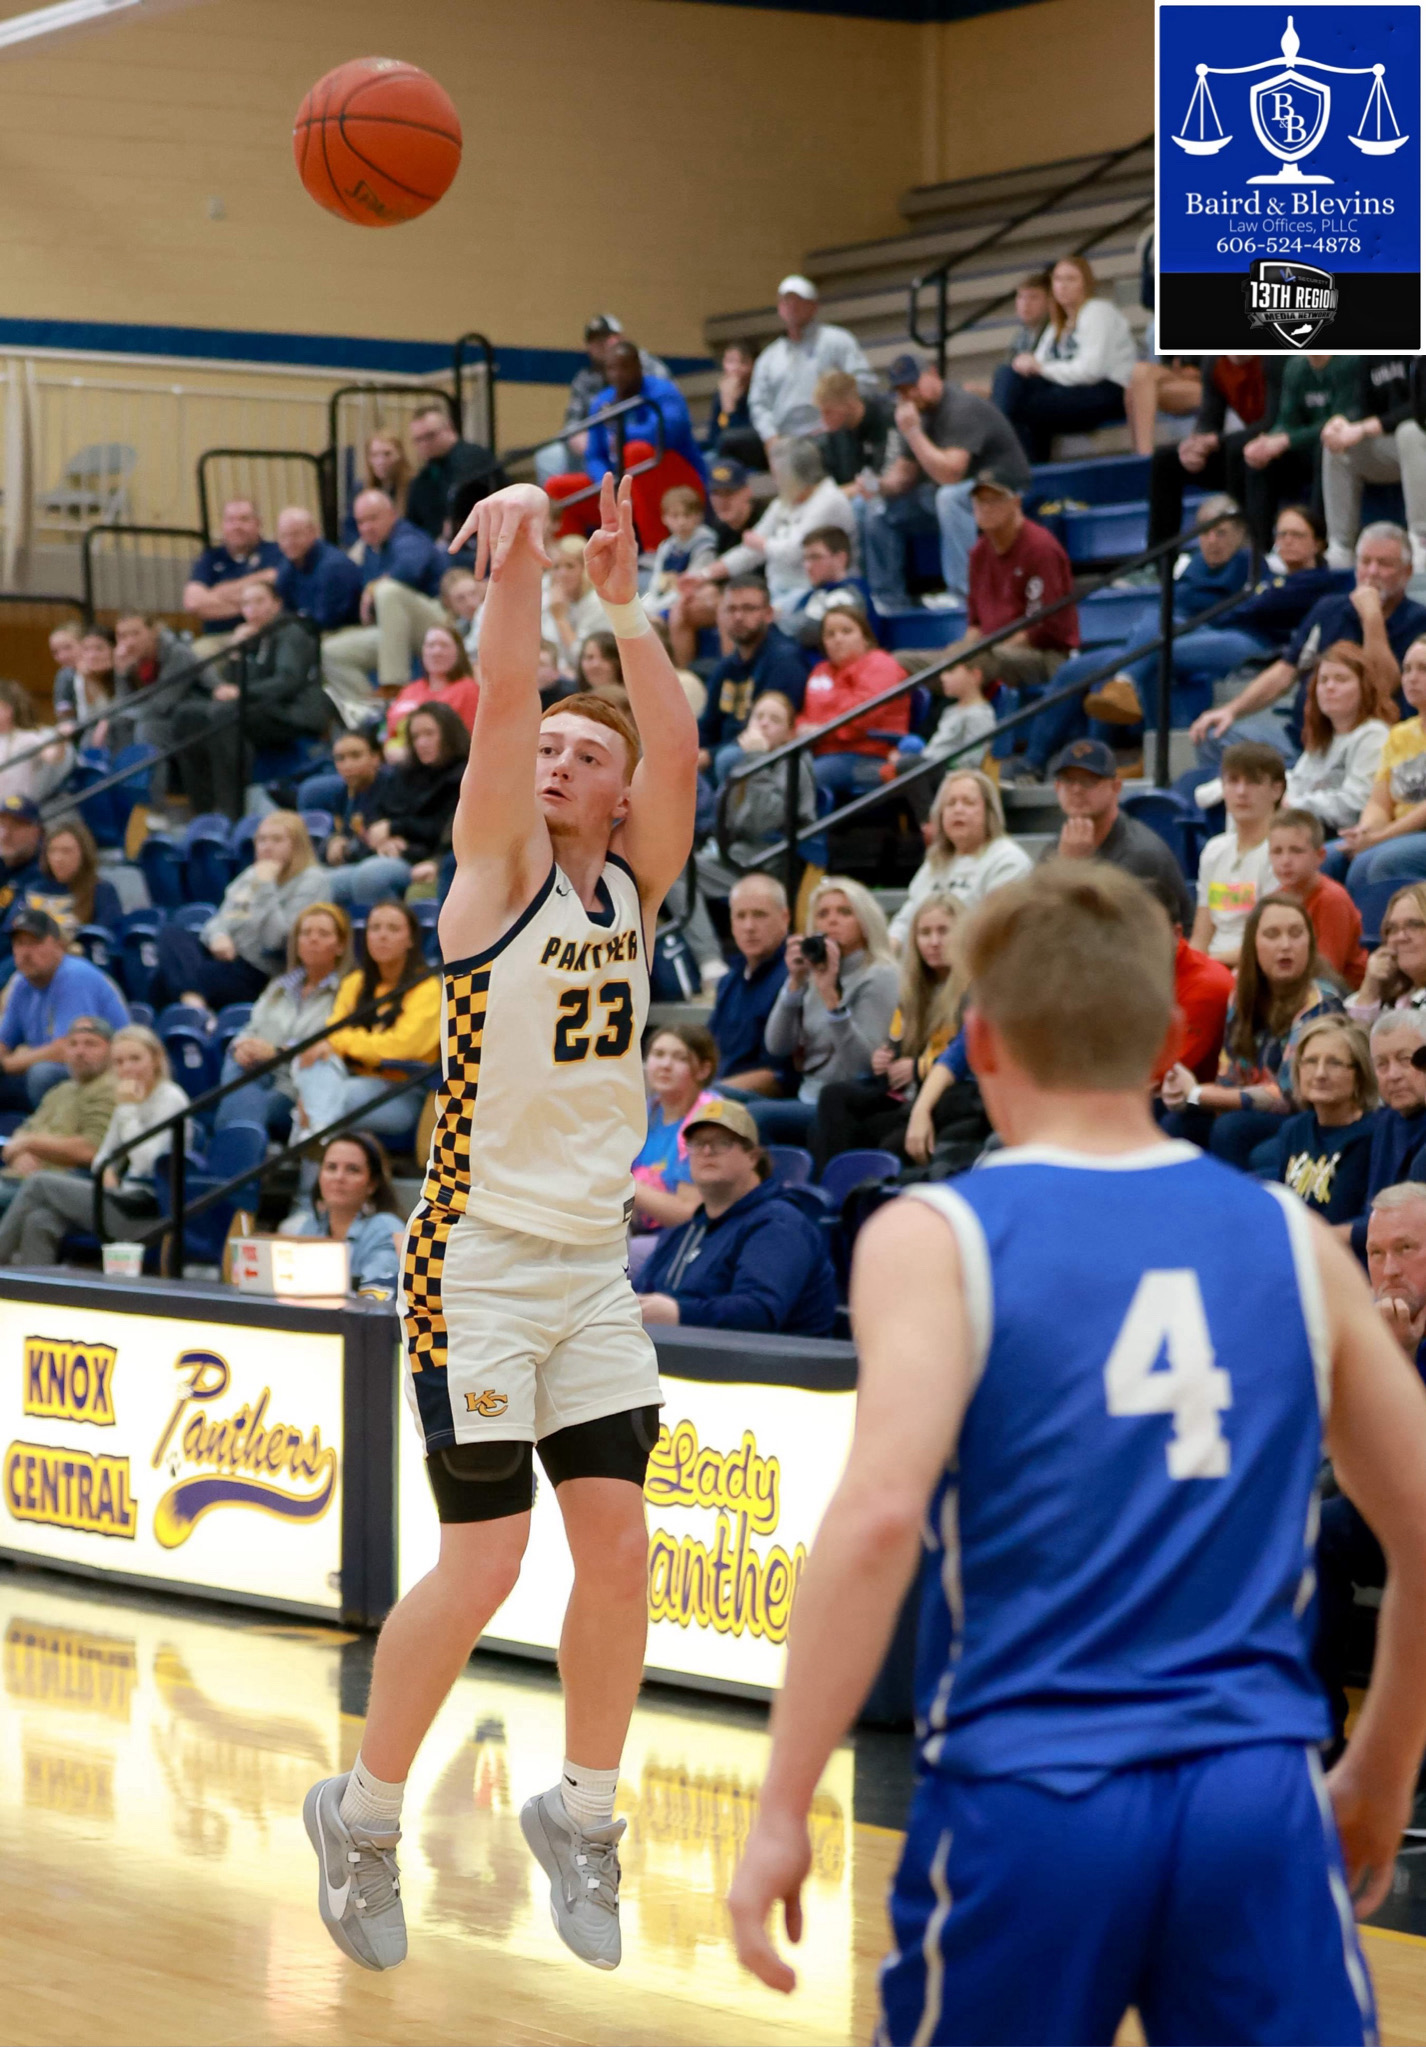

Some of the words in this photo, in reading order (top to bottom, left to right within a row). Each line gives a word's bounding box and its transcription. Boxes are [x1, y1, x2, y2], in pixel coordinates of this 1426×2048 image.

[552, 978, 635, 1066] 23
[26, 1342, 113, 1418] KNOX
[152, 1349, 330, 1485] Panthers
[464, 1389, 508, 1417] KC
[1103, 1268, 1233, 1480] 4
[7, 1447, 134, 1532] CENTRAL
[646, 1422, 779, 1532] Lady
[650, 1512, 803, 1641] anthe
